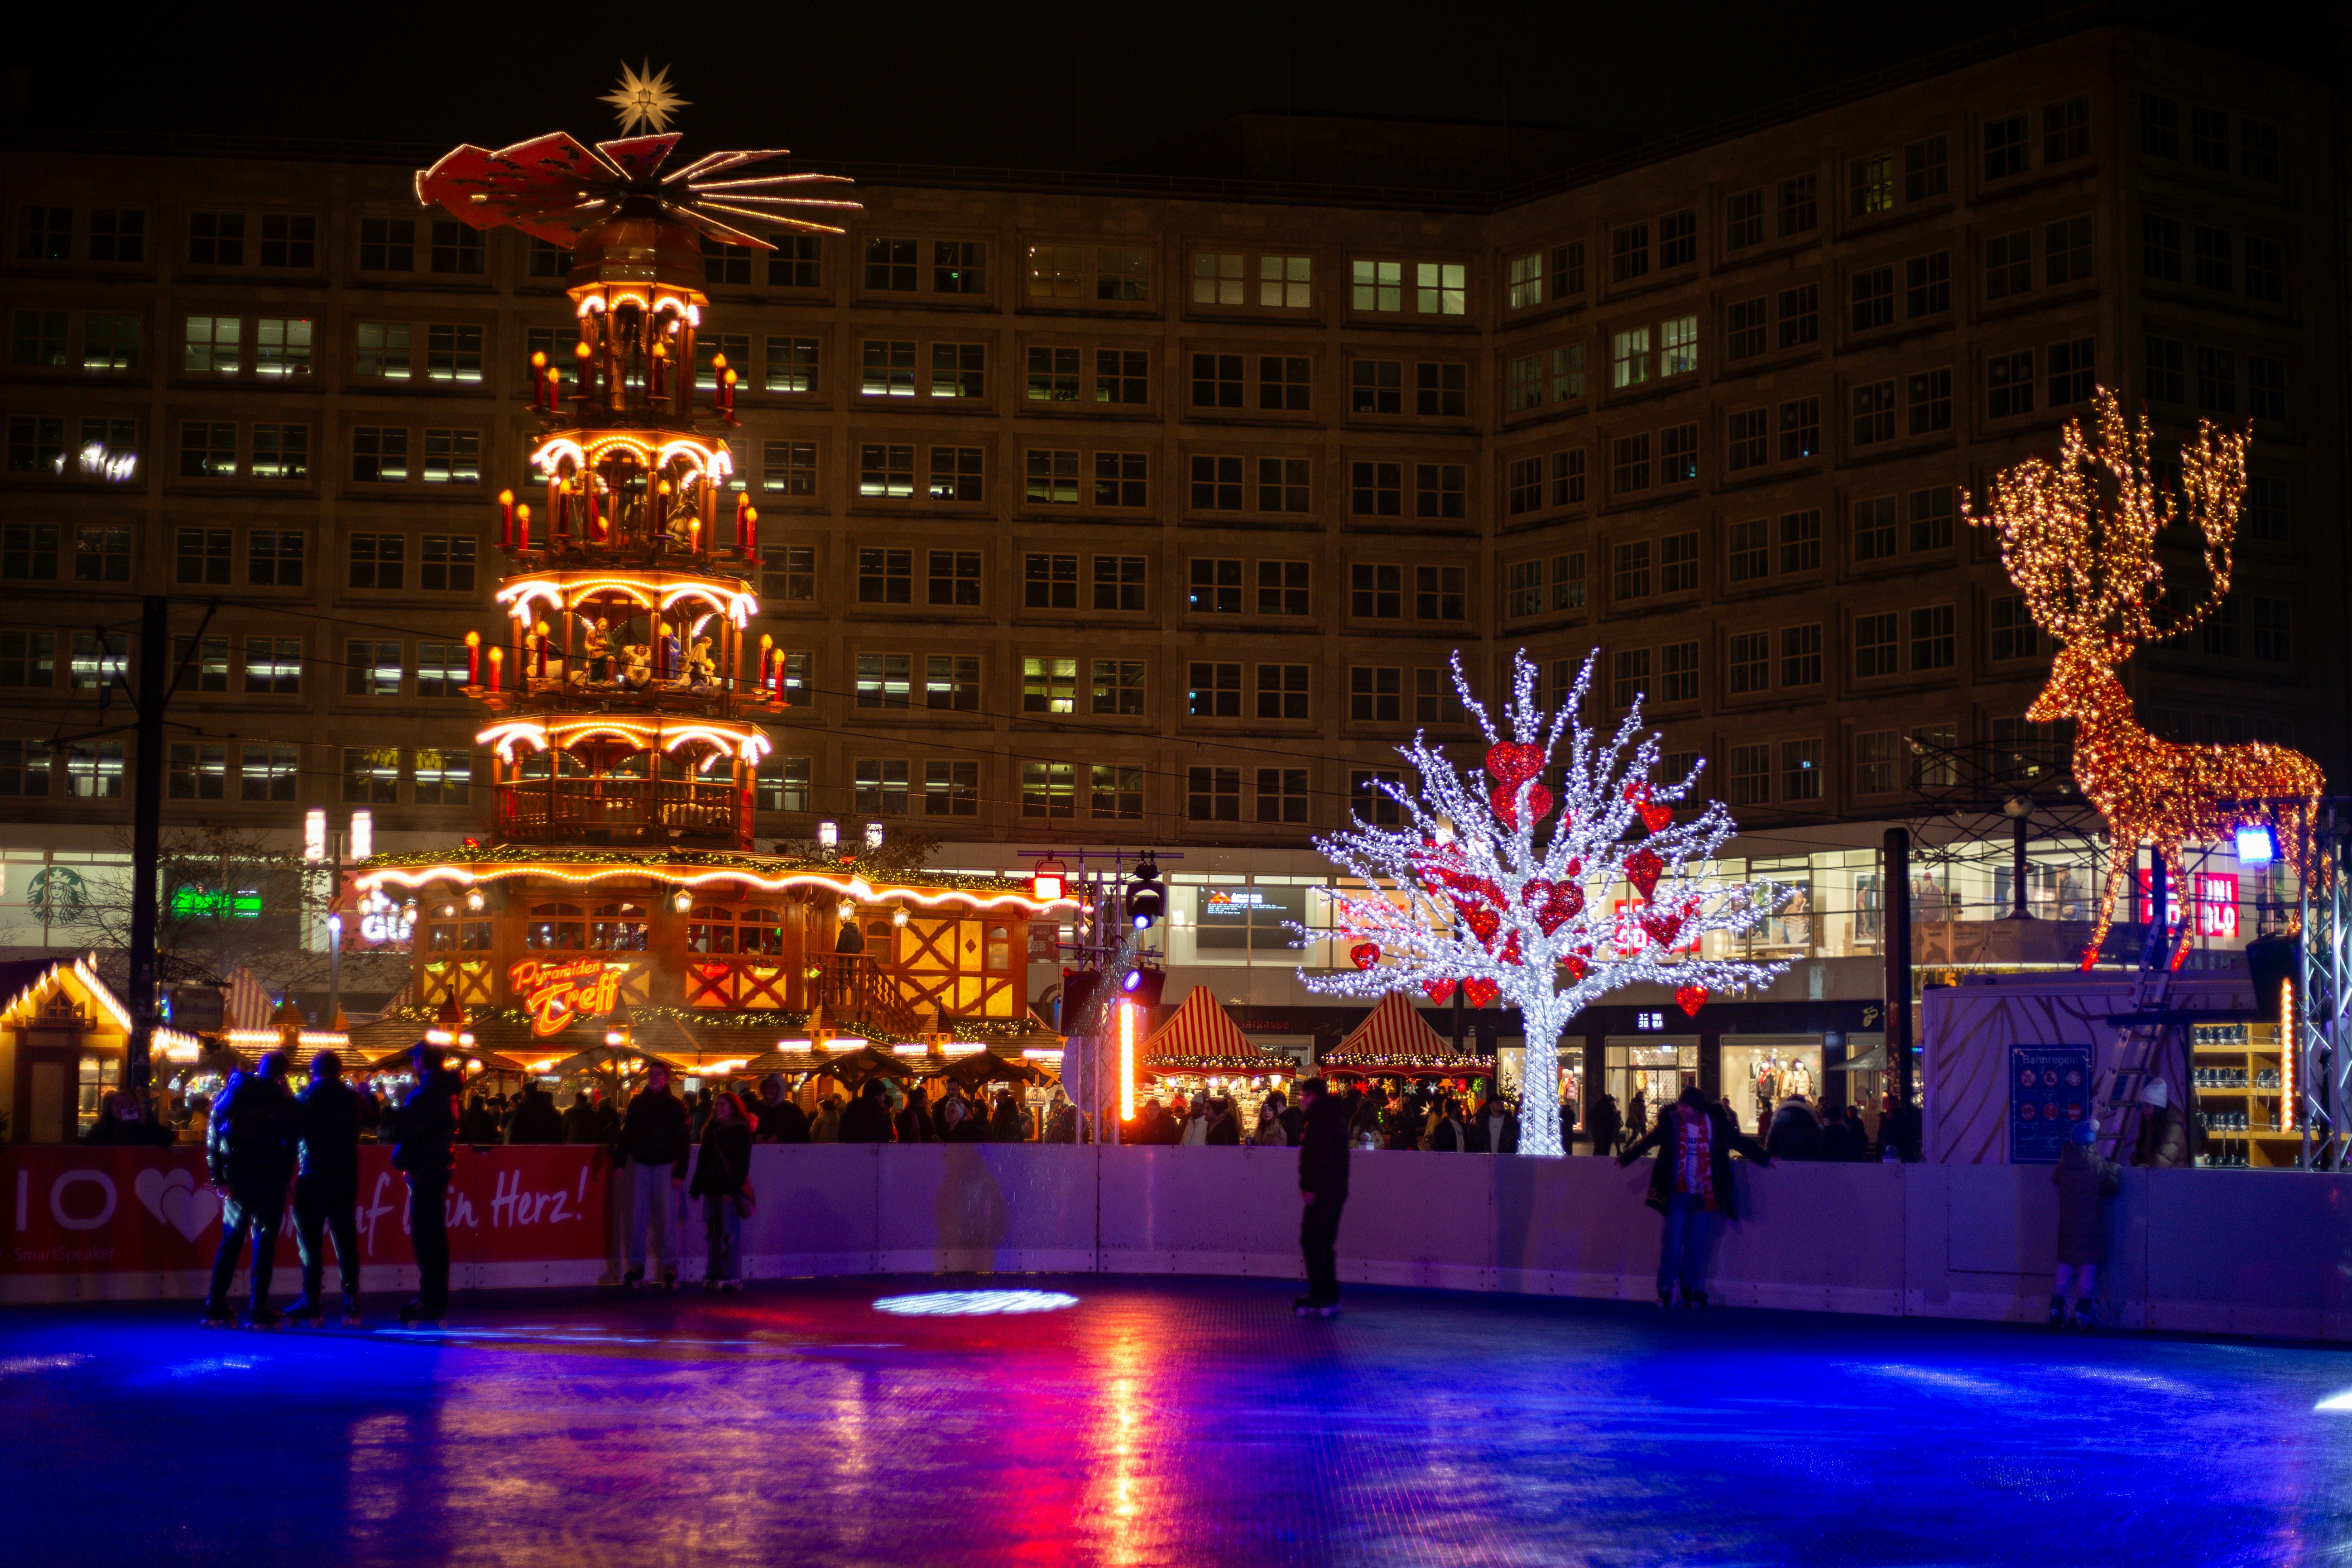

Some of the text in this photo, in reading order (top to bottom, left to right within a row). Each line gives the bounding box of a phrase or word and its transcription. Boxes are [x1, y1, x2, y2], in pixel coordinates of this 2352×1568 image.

[510, 959, 601, 990] Pyramiden
[528, 970, 620, 1034] Treff
[1234, 1018, 1289, 1029] parkasse
[2022, 1054, 2079, 1066] Bahnregeln
[490, 1165, 588, 1228] Herz!
[15, 1246, 115, 1264] SmartSpeaker
